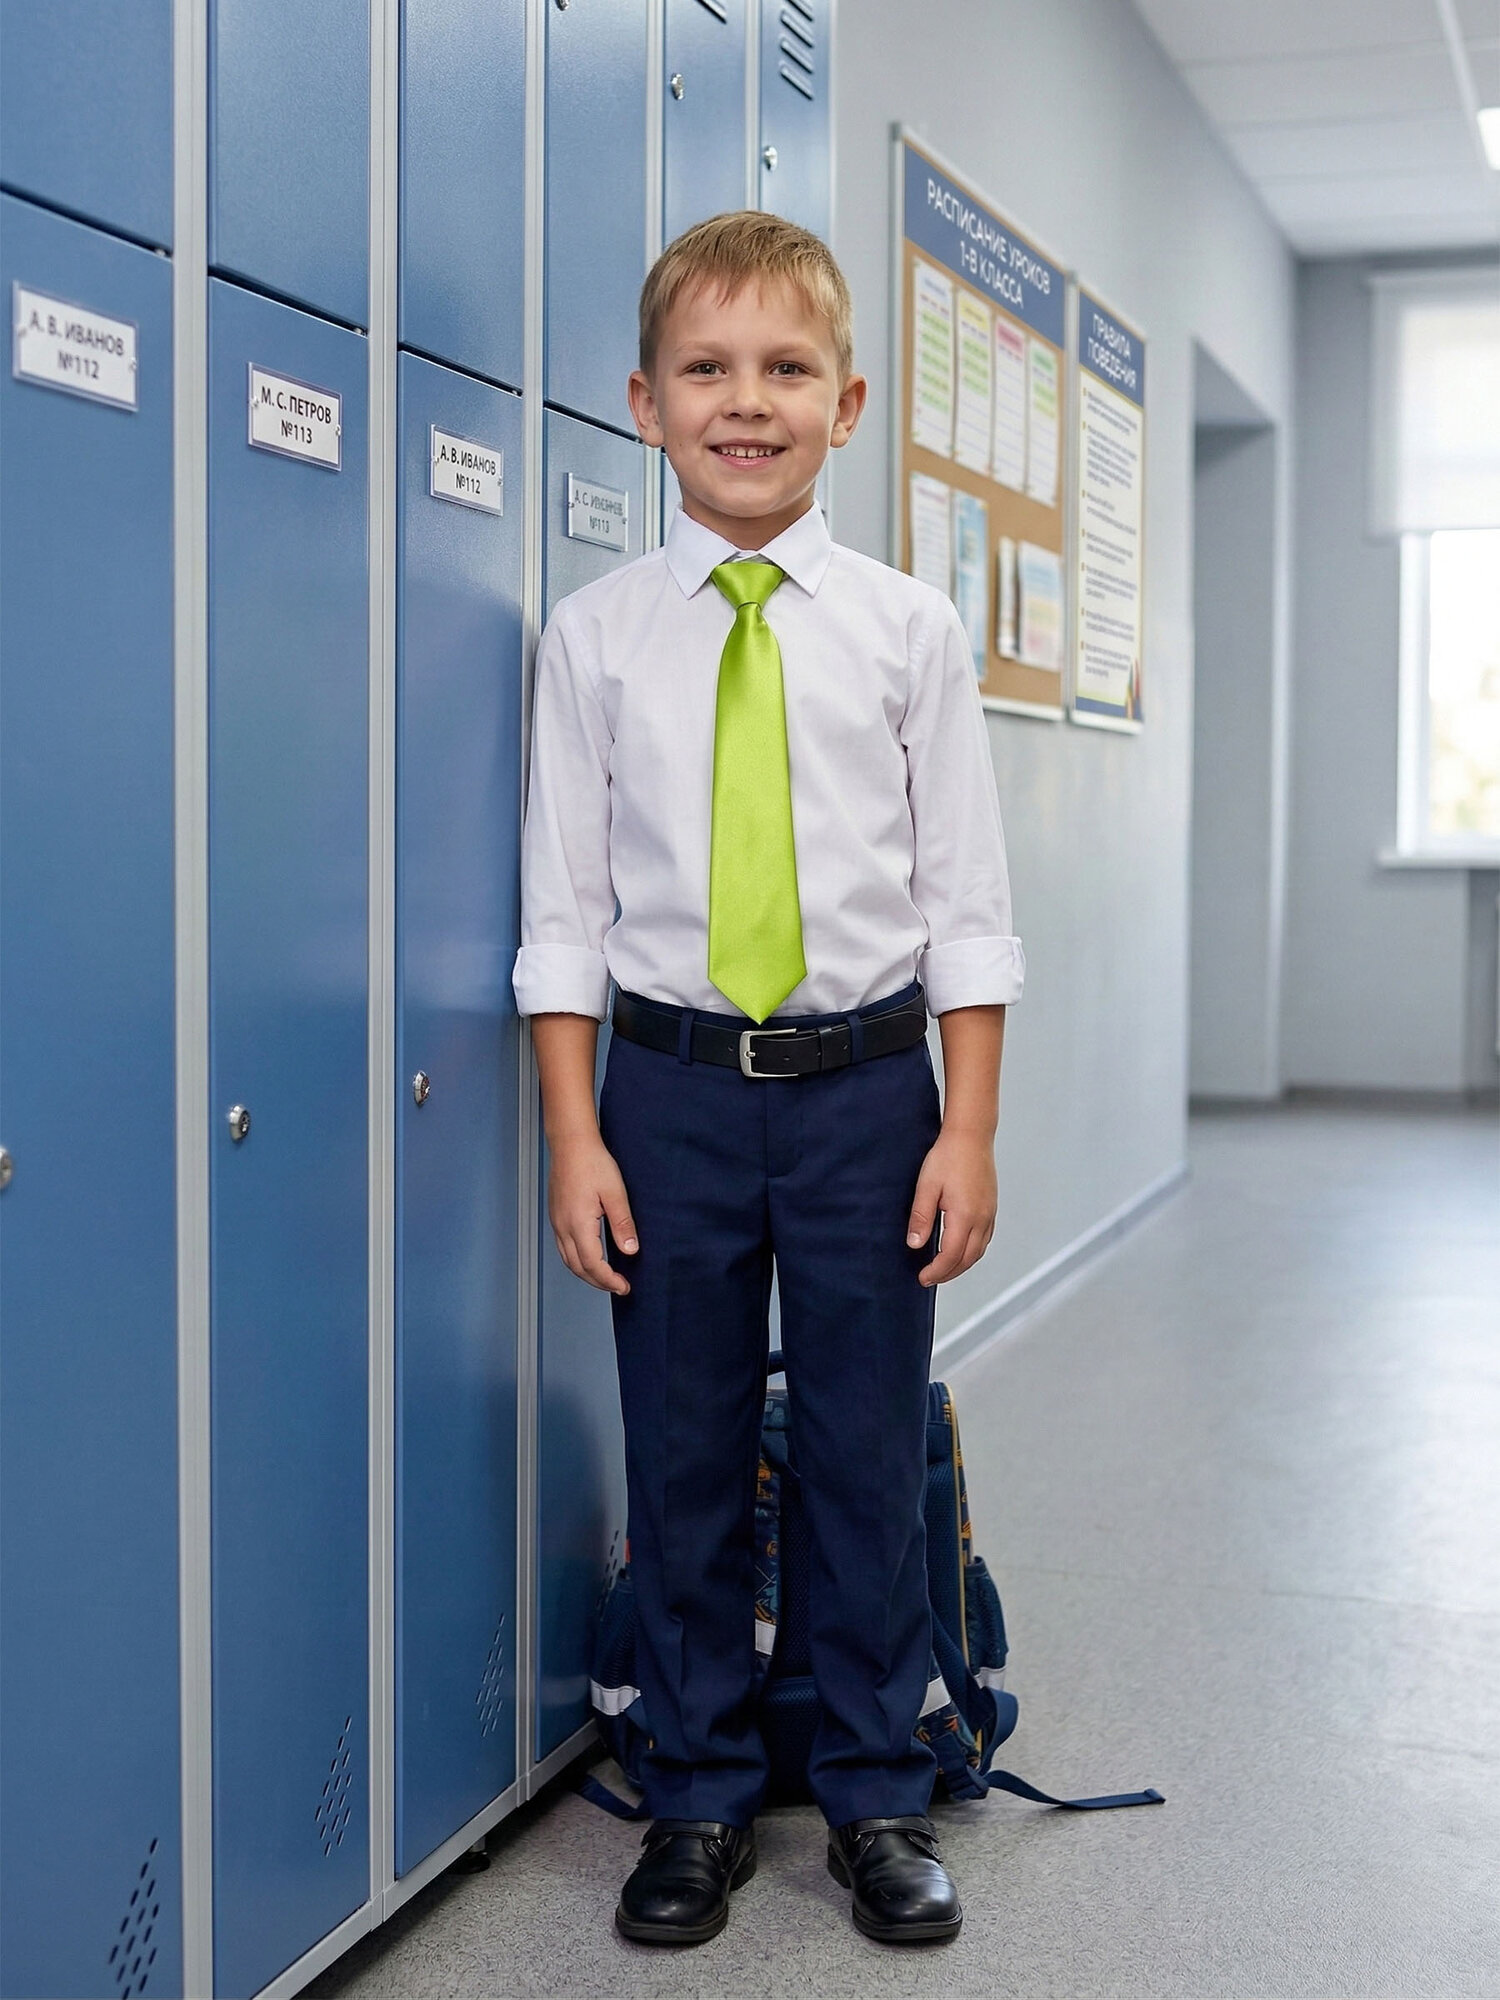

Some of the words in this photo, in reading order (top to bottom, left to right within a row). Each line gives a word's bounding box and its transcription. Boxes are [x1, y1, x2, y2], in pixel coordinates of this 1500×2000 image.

[928, 177, 1006, 263] РАСПИСАНИЕ
[1008, 241, 1050, 294] УРОКОВ
[979, 254, 1023, 309] КЛАССА
[64, 320, 124, 356] ИВАНОВ
[57, 349, 99, 379] №112
[261, 385, 275, 406] М.
[276, 391, 287, 410] С.
[289, 395, 332, 424] ПЕТРОВ
[281, 419, 313, 444] №113
[440, 444, 449, 461] А.
[451, 447, 459, 464] В.
[461, 450, 496, 476] ИВАНОВ
[455, 472, 481, 494] №112
